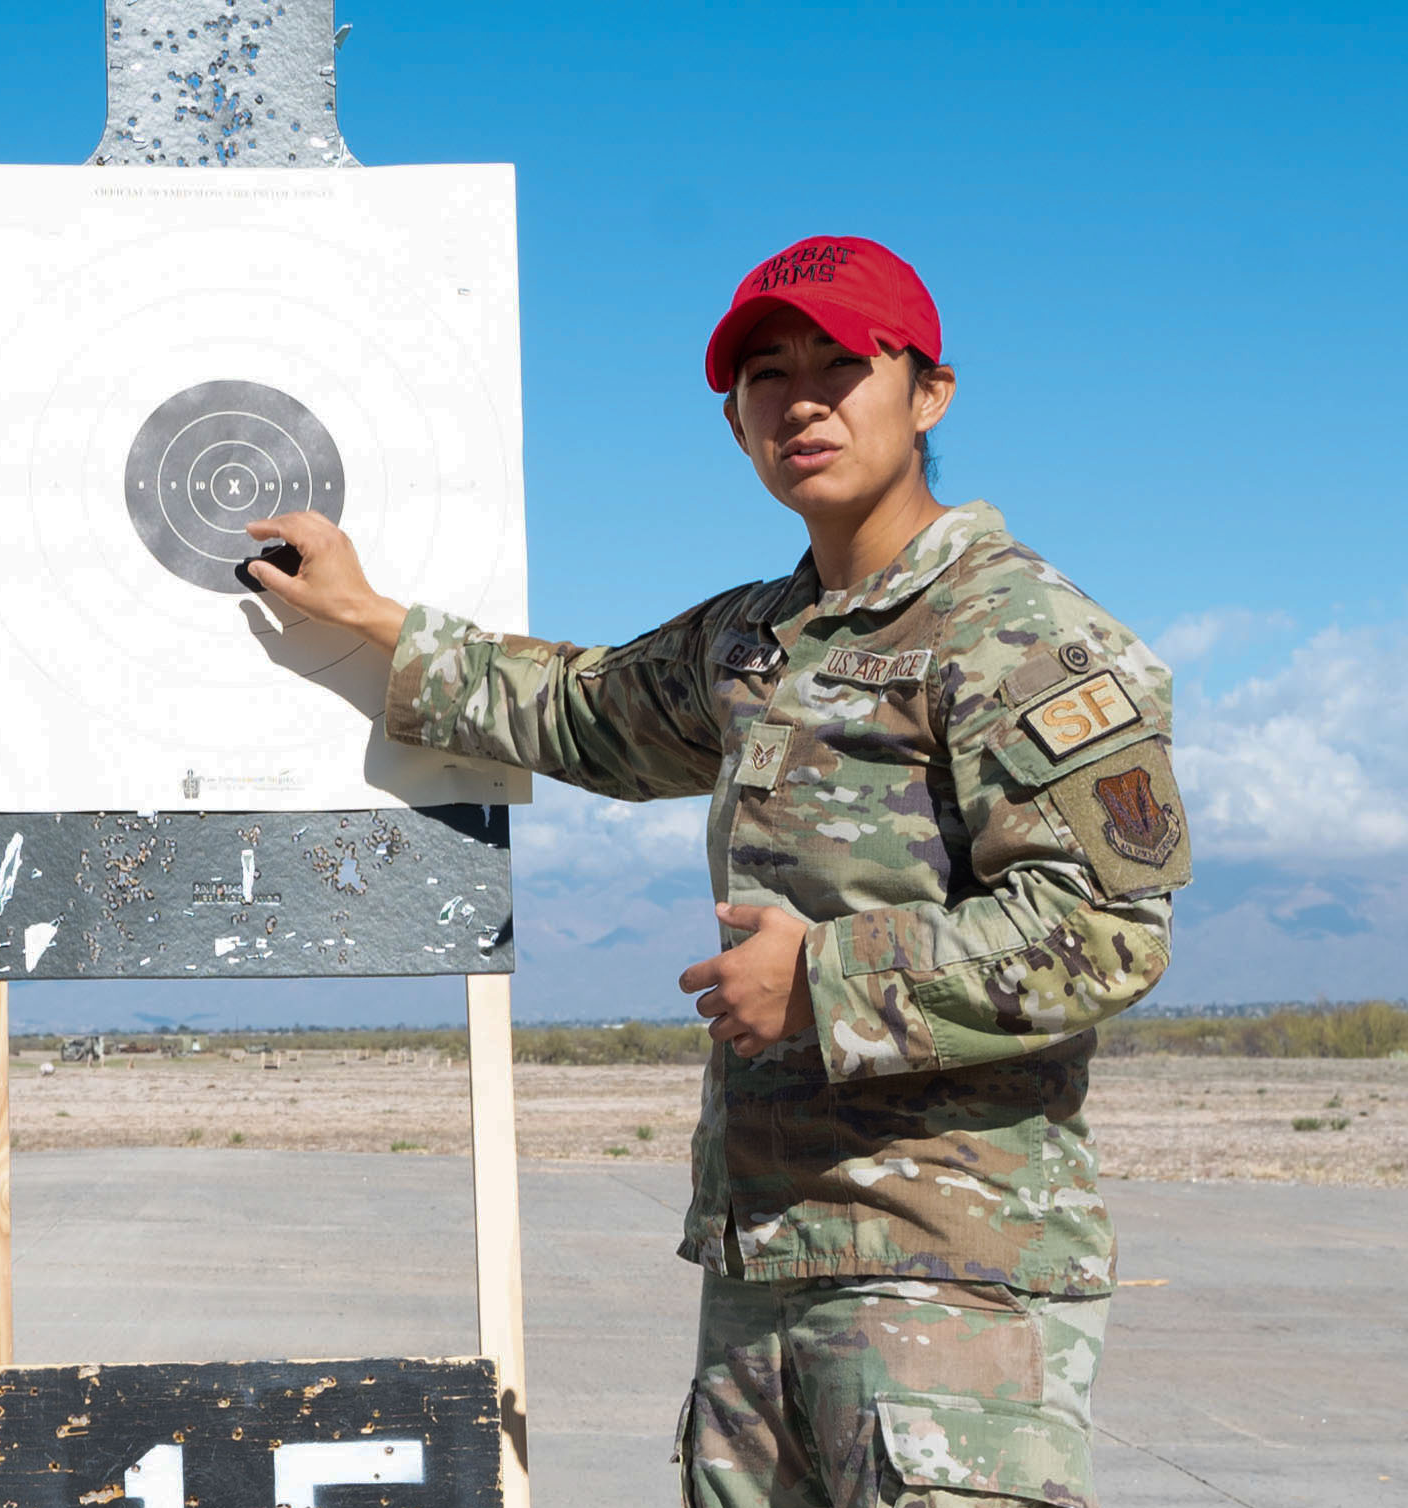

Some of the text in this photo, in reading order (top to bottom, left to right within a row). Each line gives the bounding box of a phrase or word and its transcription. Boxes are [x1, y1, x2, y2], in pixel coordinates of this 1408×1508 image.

[759, 264, 835, 292] ARMS
[138, 481, 145, 490] 8
[195, 481, 206, 491] 10
[228, 479, 241, 495] X
[264, 482, 275, 491] 10
[292, 481, 299, 491] 9
[324, 481, 331, 490] 8
[852, 655, 887, 681] AIR
[885, 653, 922, 682] RCE
[1042, 680, 1115, 743] SF
